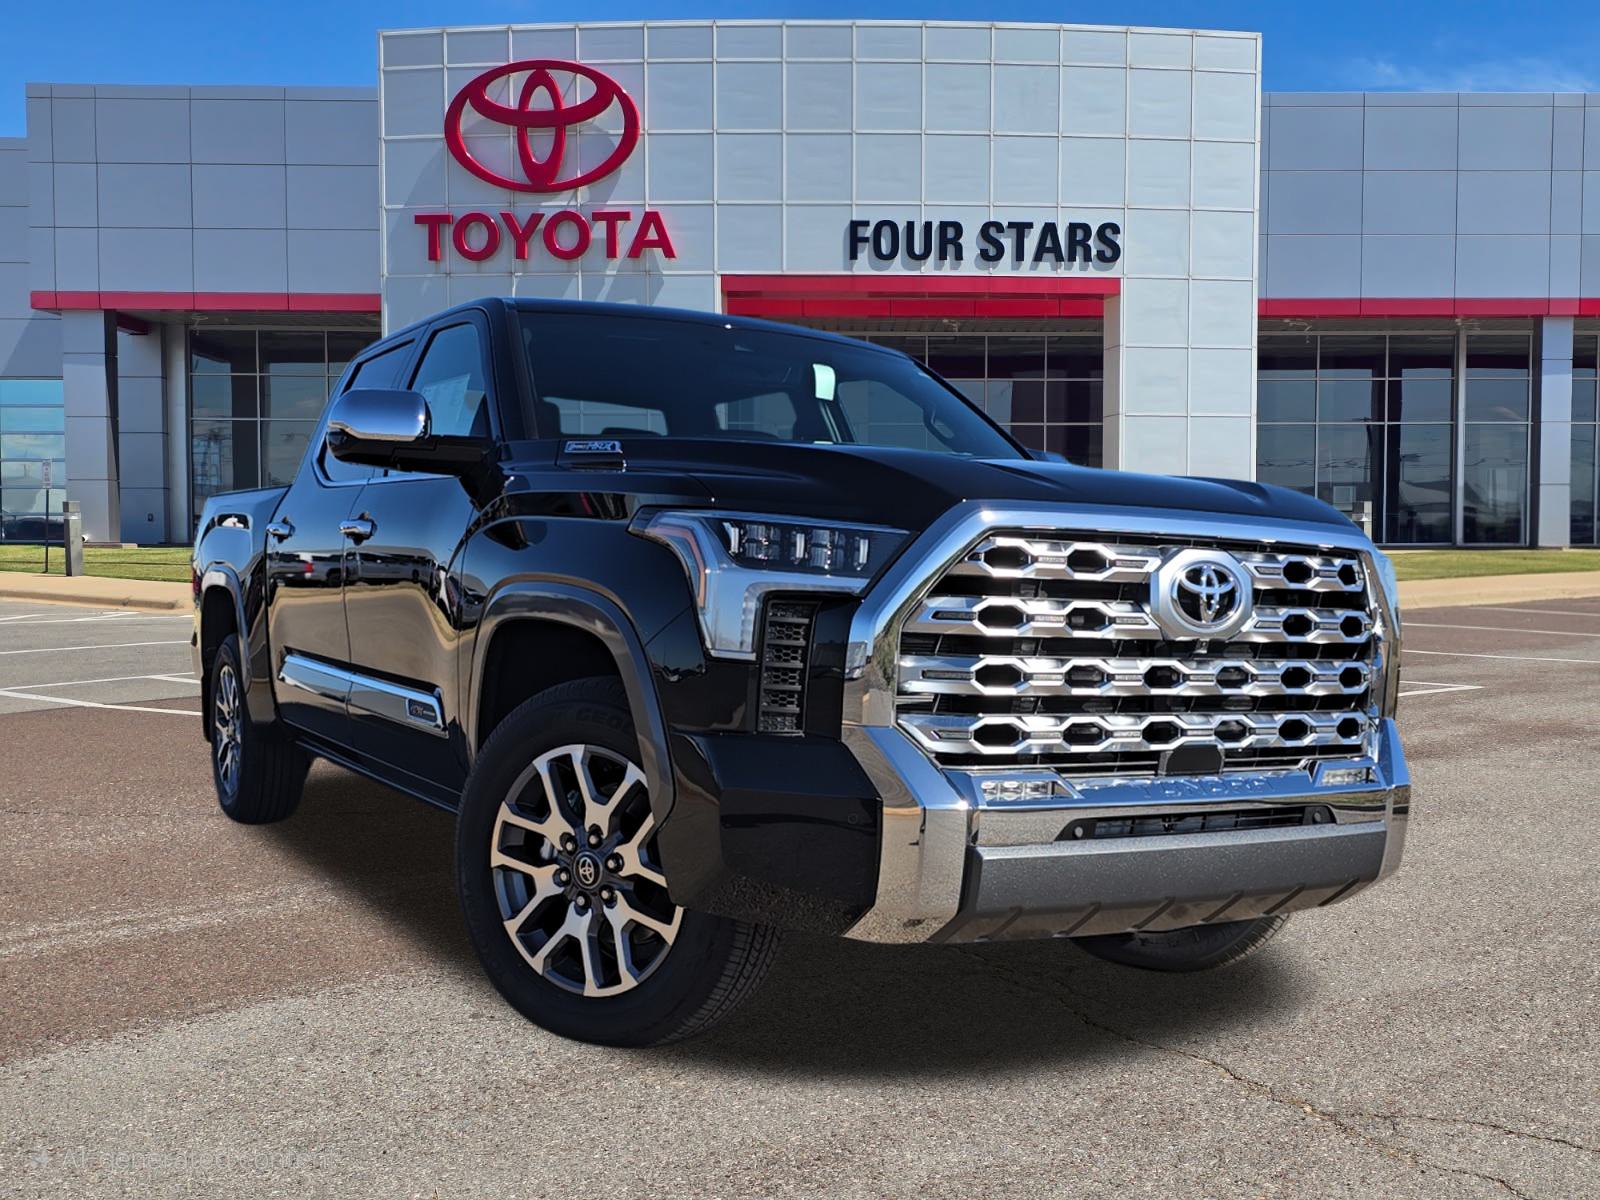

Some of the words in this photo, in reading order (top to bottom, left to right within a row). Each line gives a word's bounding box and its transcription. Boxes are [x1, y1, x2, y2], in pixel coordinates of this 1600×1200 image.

[414, 210, 677, 262] TOYOTA
[849, 219, 963, 261] FOUR
[979, 221, 1122, 263] STARS
